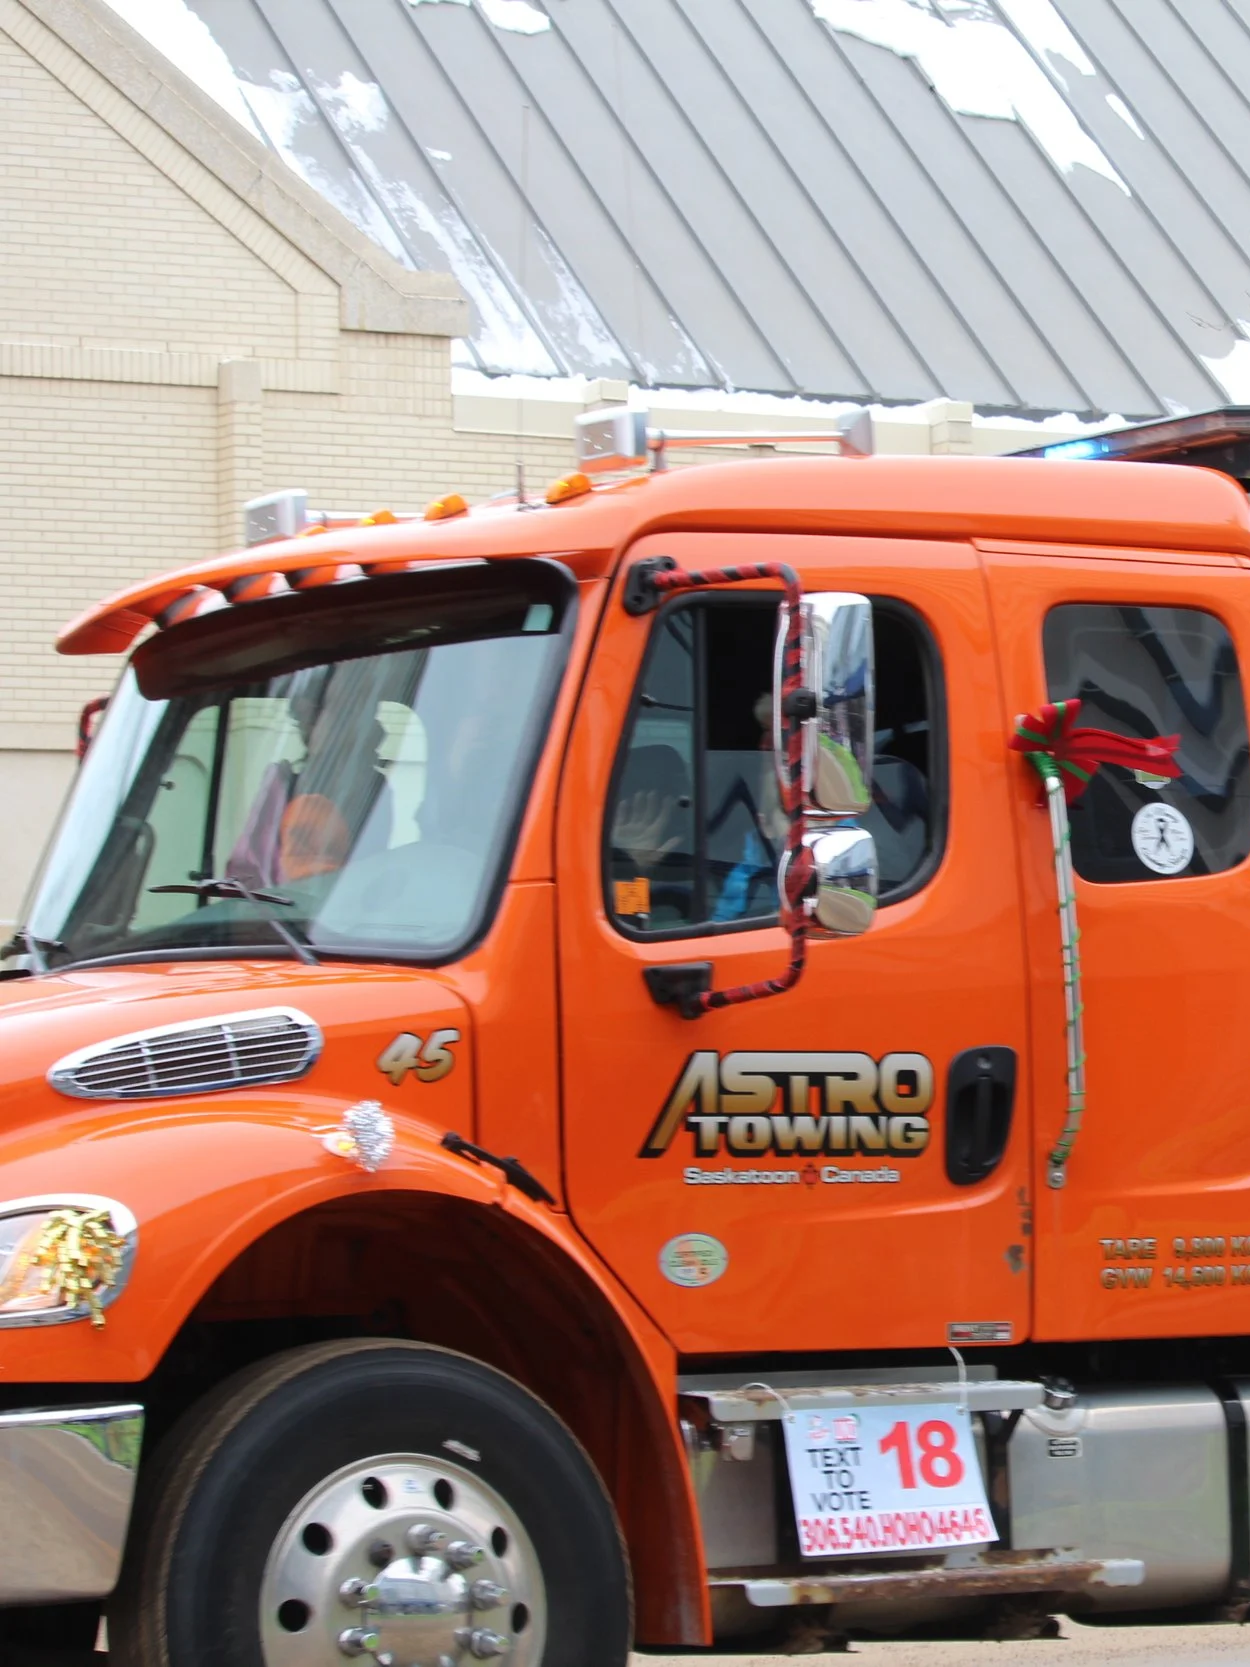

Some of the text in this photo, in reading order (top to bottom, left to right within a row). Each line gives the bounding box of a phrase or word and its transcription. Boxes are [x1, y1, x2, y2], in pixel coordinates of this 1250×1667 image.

[376, 1027, 462, 1087] 45
[637, 1050, 935, 1158] ASTRO
[684, 1115, 931, 1158] TOWING
[683, 1165, 900, 1185] Saskatoon Canada
[1098, 1237, 1157, 1260] TARE
[1101, 1267, 1153, 1289] GVW
[805, 1447, 862, 1468] TEXT
[877, 1419, 965, 1490] 18
[822, 1469, 855, 1489] TO
[810, 1491, 872, 1512] VOTE
